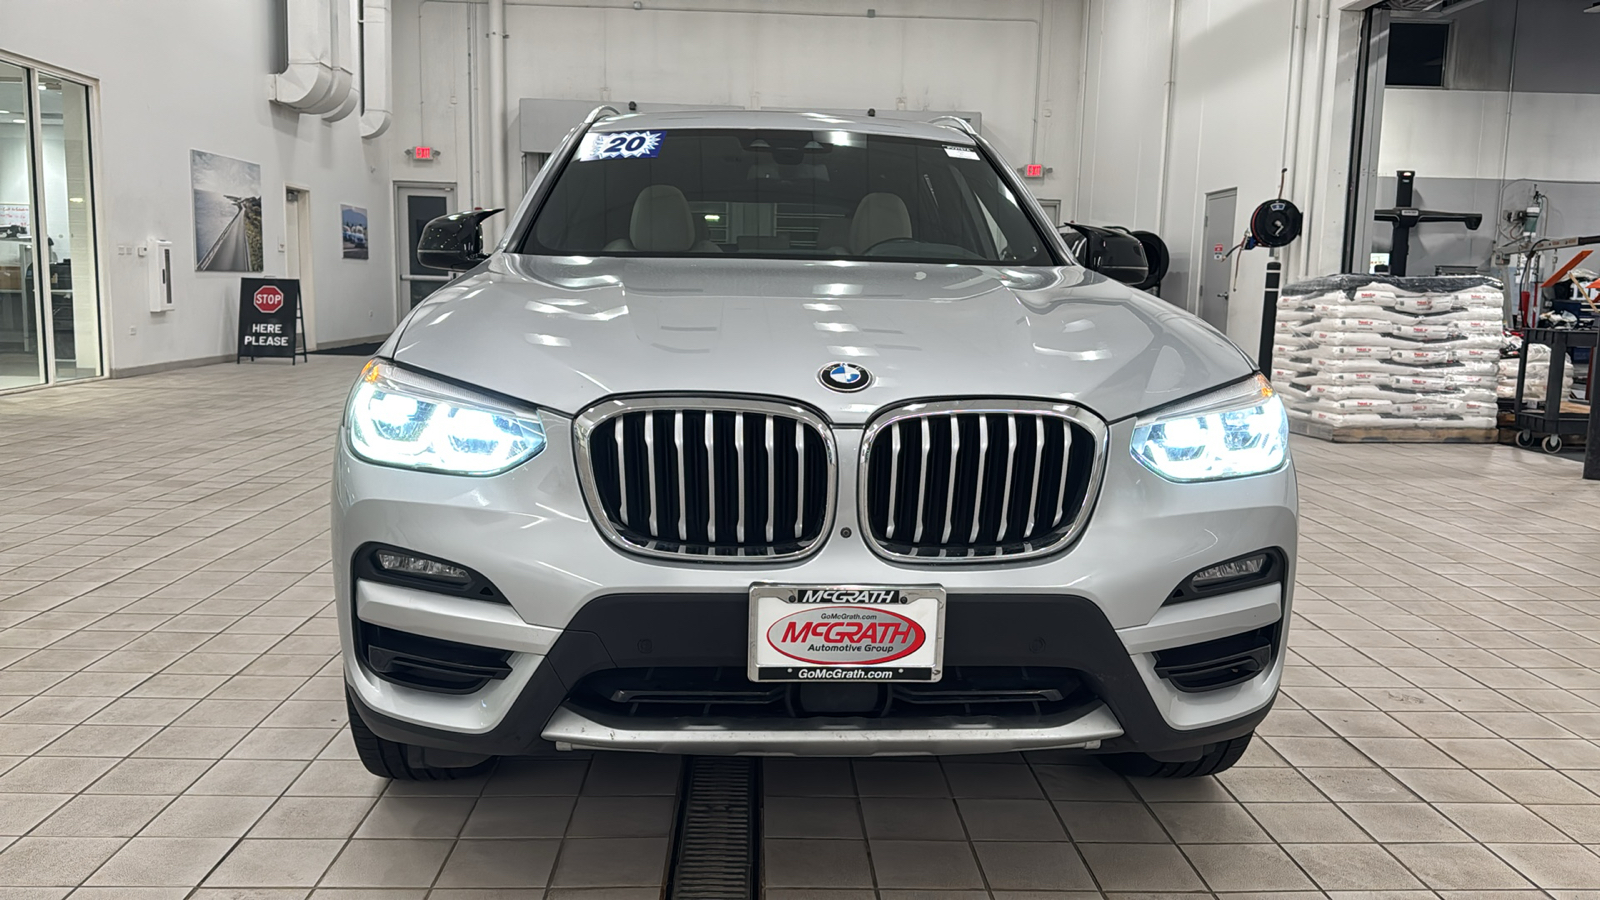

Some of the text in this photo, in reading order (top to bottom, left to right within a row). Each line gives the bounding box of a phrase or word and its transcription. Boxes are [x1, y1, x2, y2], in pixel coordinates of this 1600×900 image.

[603, 136, 646, 153] 20
[416, 146, 431, 159] EXIT
[1027, 164, 1042, 176] EXIT
[256, 294, 282, 305] STOP
[252, 323, 282, 334] HERE
[244, 335, 289, 347] PLEASE
[820, 613, 878, 621] GoMcGrath.com
[807, 644, 894, 654] Automotive Group
[798, 669, 893, 680] GoMcGrath.com
